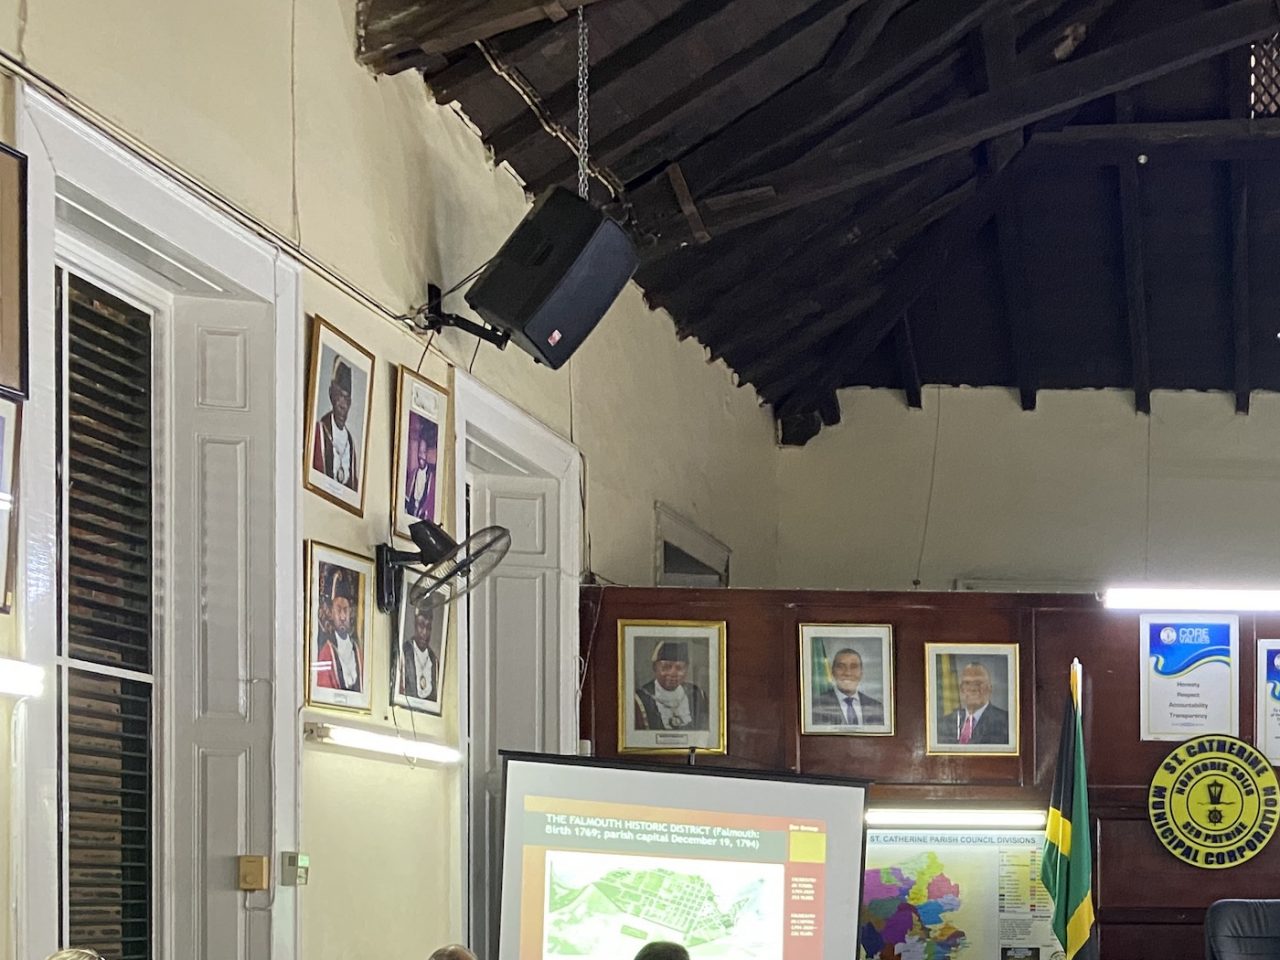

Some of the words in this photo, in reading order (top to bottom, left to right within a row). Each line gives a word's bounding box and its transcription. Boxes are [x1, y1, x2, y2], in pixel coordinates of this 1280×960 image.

[1179, 628, 1209, 637] CORE
[1163, 753, 1186, 775] ST.
[1186, 739, 1269, 778] CATHERINE
[545, 814, 568, 824] THE
[569, 816, 622, 828] FALMOUTH
[625, 820, 668, 832] HISTORIC
[670, 823, 711, 836] DISTRICT
[545, 825, 572, 836] Birth
[604, 829, 634, 841] parish
[636, 831, 669, 843] capital
[671, 833, 718, 847] December
[1151, 785, 1200, 863] MUNICIPAL
[1204, 786, 1278, 865] CORPORATION
[883, 836, 927, 844] CATHERINE
[930, 836, 958, 844] PARISH
